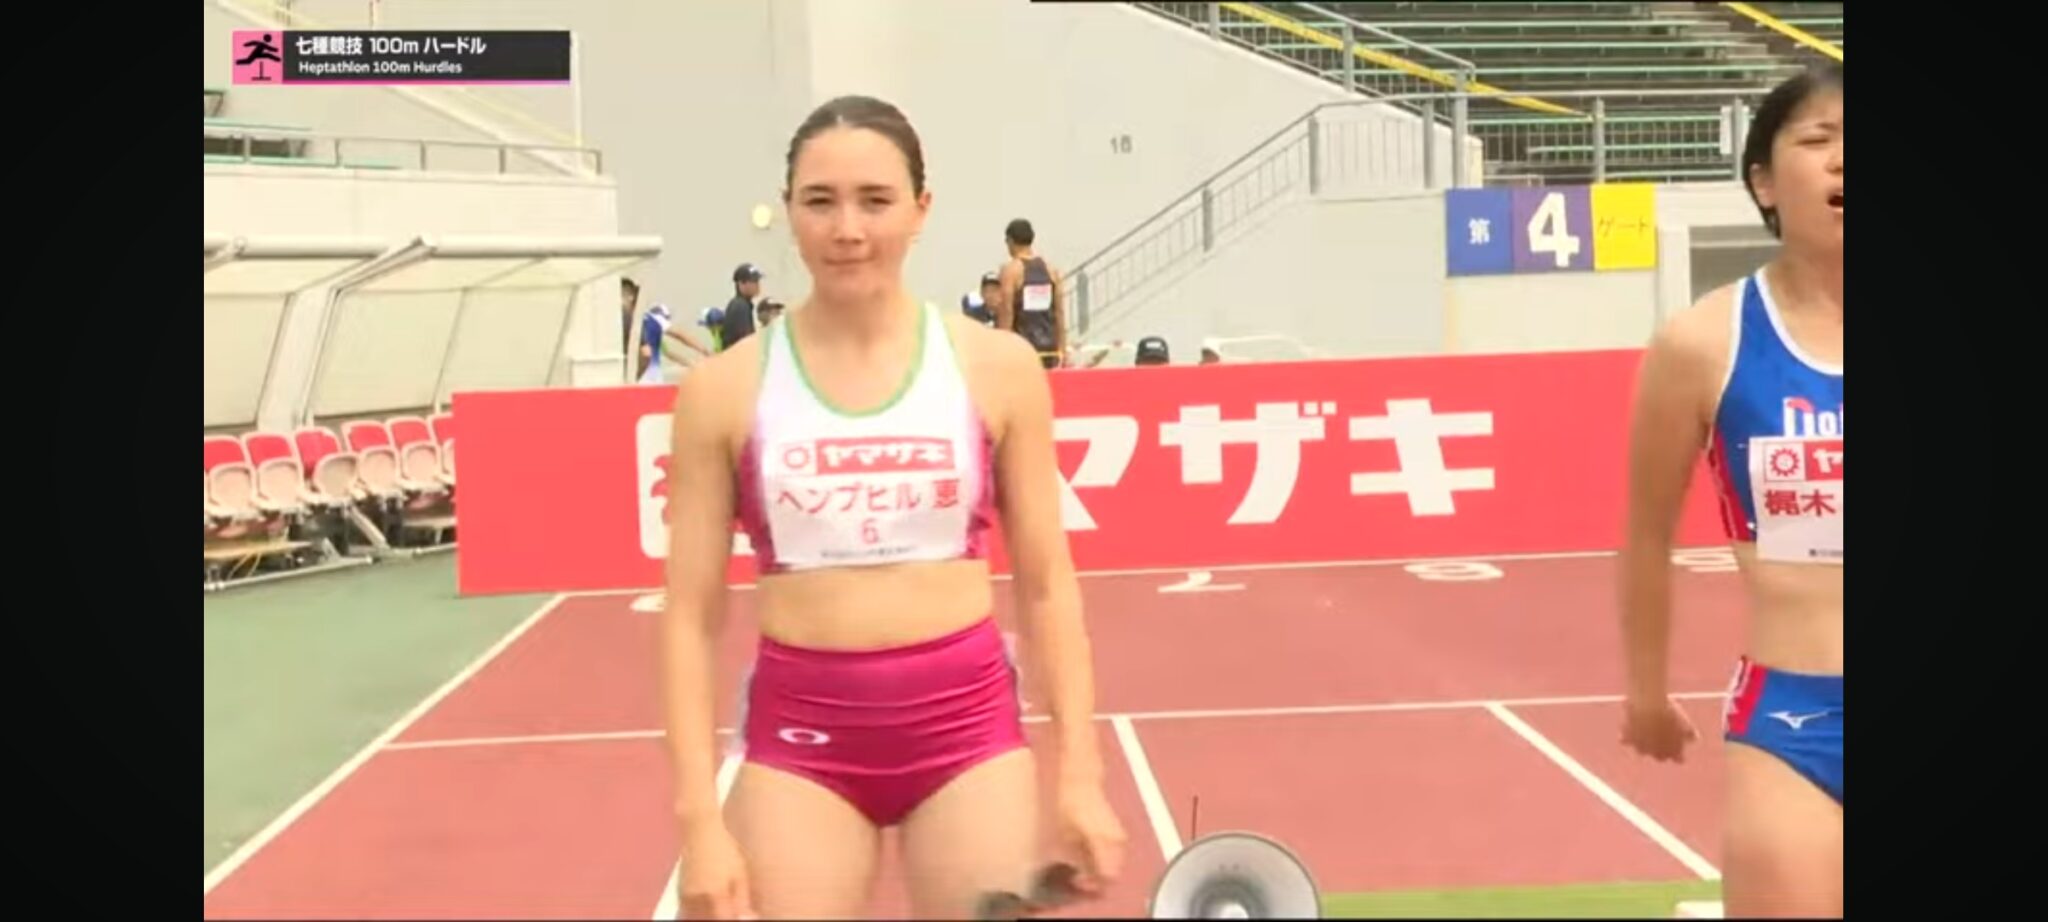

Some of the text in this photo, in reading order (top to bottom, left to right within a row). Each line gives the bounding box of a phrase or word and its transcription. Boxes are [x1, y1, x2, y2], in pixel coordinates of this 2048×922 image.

[1468, 191, 1650, 268] 第 4 ゲート
[824, 444, 946, 466] ヤマザキ
[1053, 396, 1495, 530] マザキ
[777, 481, 922, 515] ヘンプヒル
[861, 517, 880, 544] 6
